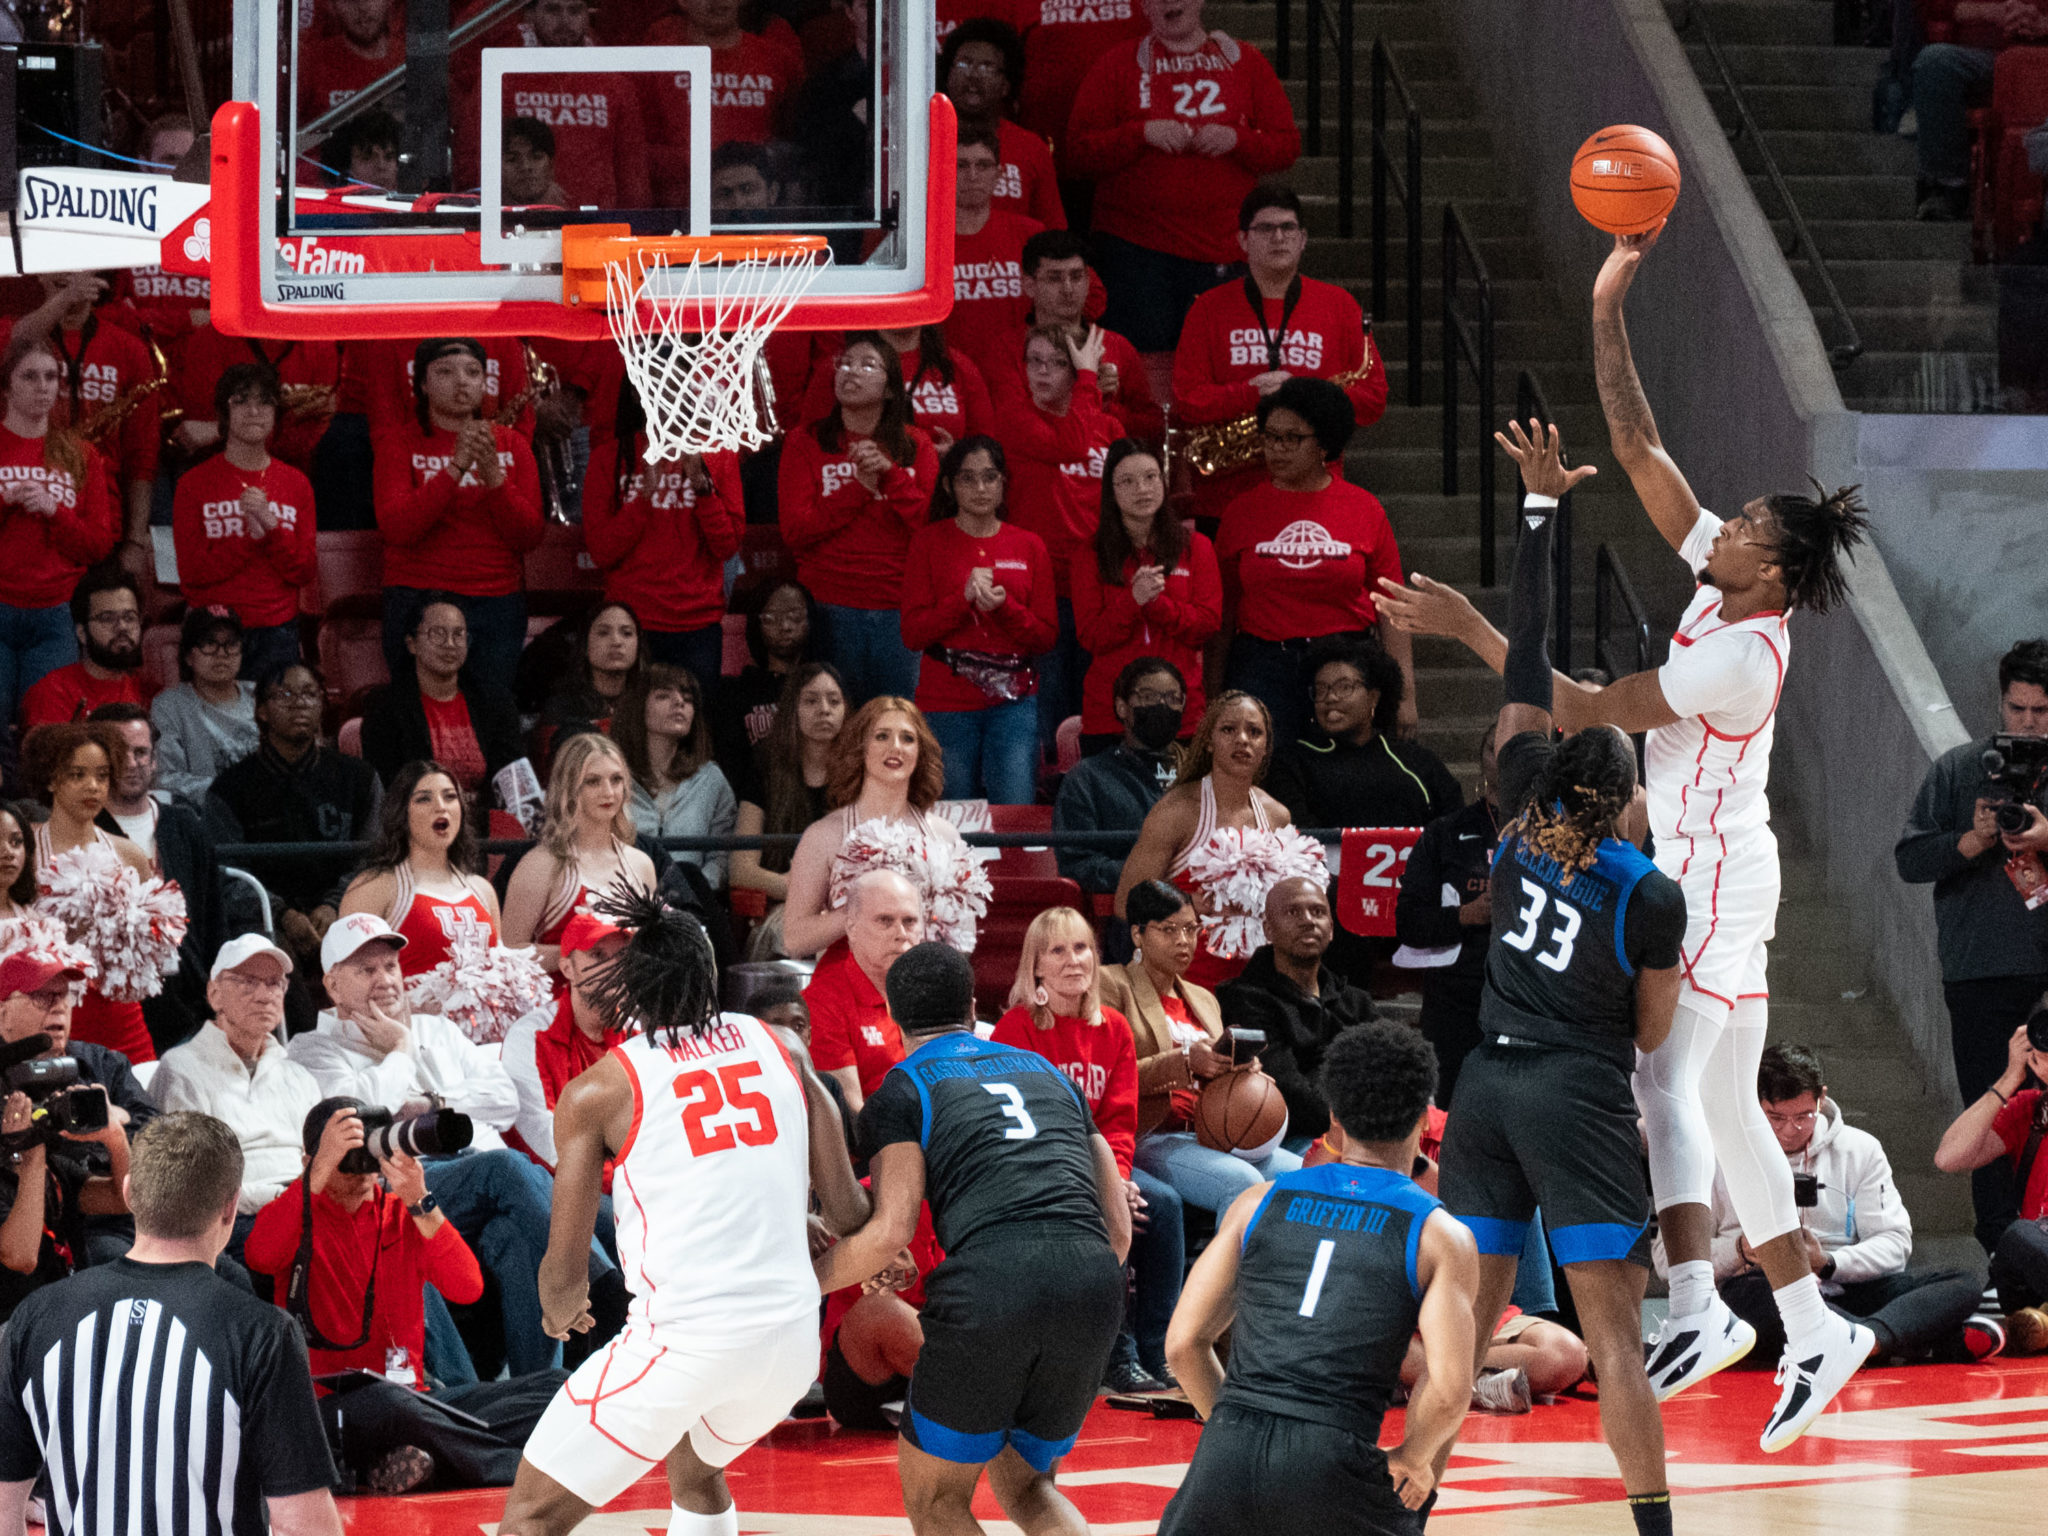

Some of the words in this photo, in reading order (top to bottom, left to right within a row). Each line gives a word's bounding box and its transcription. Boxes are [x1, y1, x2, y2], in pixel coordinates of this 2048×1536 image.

[1041, 3, 1133, 26] BRASS
[515, 91, 608, 110] COUGAR
[674, 73, 773, 91] CUGAR
[1172, 79, 1227, 118] 22
[24, 175, 157, 232] SPALDING
[298, 236, 366, 274] Farm
[278, 283, 345, 302] SPALDING
[954, 279, 1022, 300] RASS
[1254, 541, 1352, 557] HOUSTON
[1501, 876, 1582, 972] 33
[660, 1023, 746, 1063] WALKER
[672, 1060, 778, 1158] 25
[979, 1082, 1037, 1139] 3
[1285, 1196, 1365, 1231] GRIFFIN
[1362, 1207, 1391, 1235] III
[1299, 1239, 1336, 1318] 1
